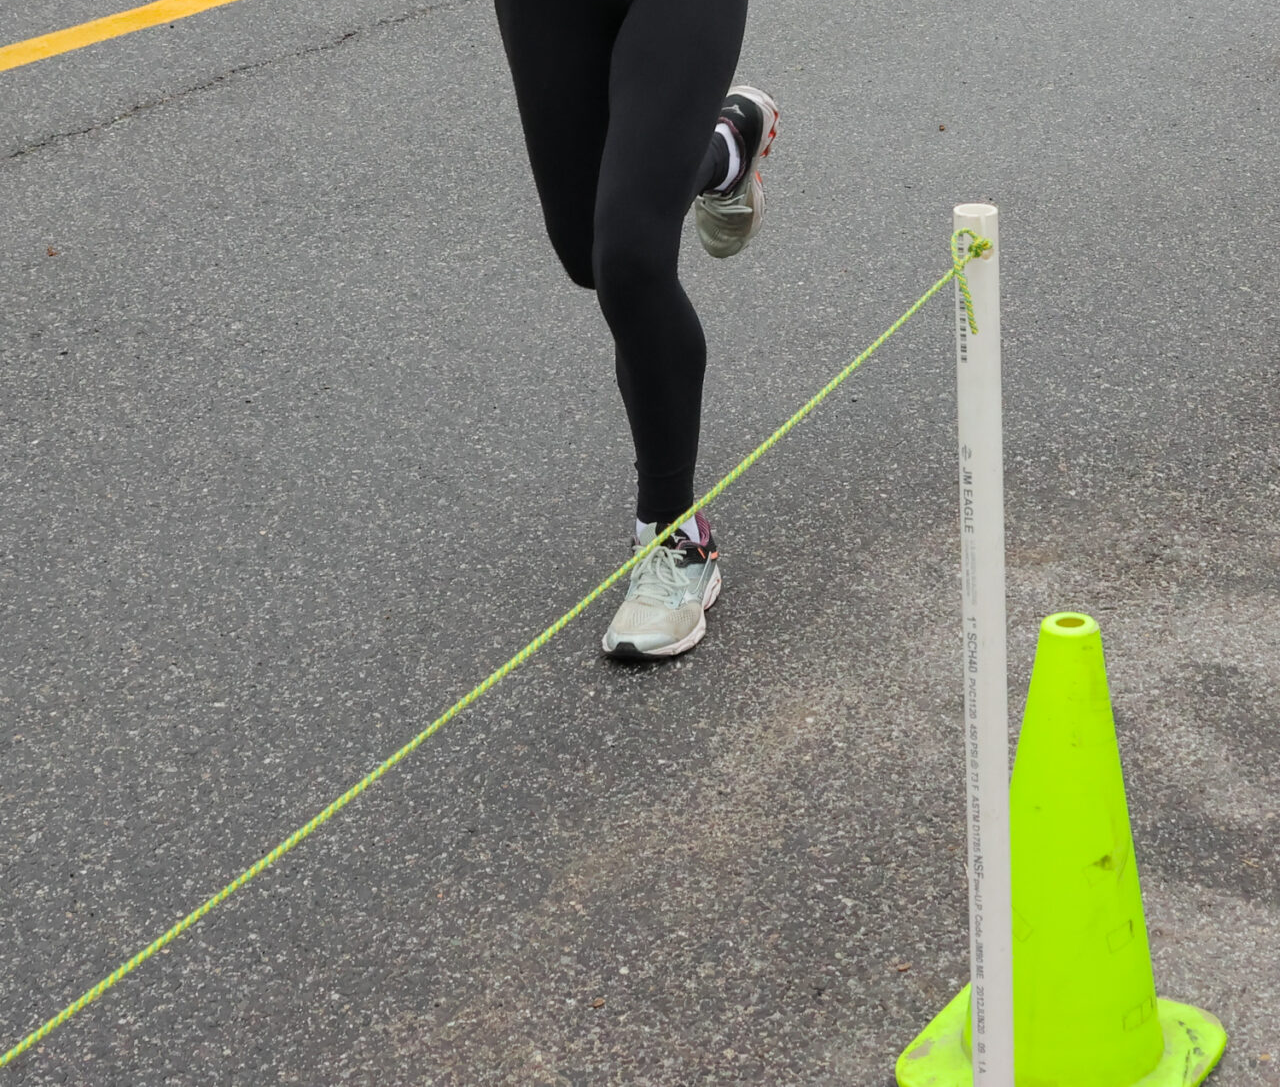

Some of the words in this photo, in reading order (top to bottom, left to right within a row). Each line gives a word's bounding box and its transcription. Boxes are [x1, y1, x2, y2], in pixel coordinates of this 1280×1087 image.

[963, 467, 973, 485] JM
[963, 489, 975, 534] EAGLE
[967, 632, 979, 673] SCH40
[969, 678, 978, 720] PVC1120
[969, 724, 979, 741] 450
[970, 742, 979, 759] PSI
[971, 772, 980, 783] 73
[971, 784, 980, 792] F
[972, 795, 981, 822] ASTM
[972, 824, 981, 853] D1785
[975, 914, 984, 938] Code
[976, 964, 985, 980] ME
